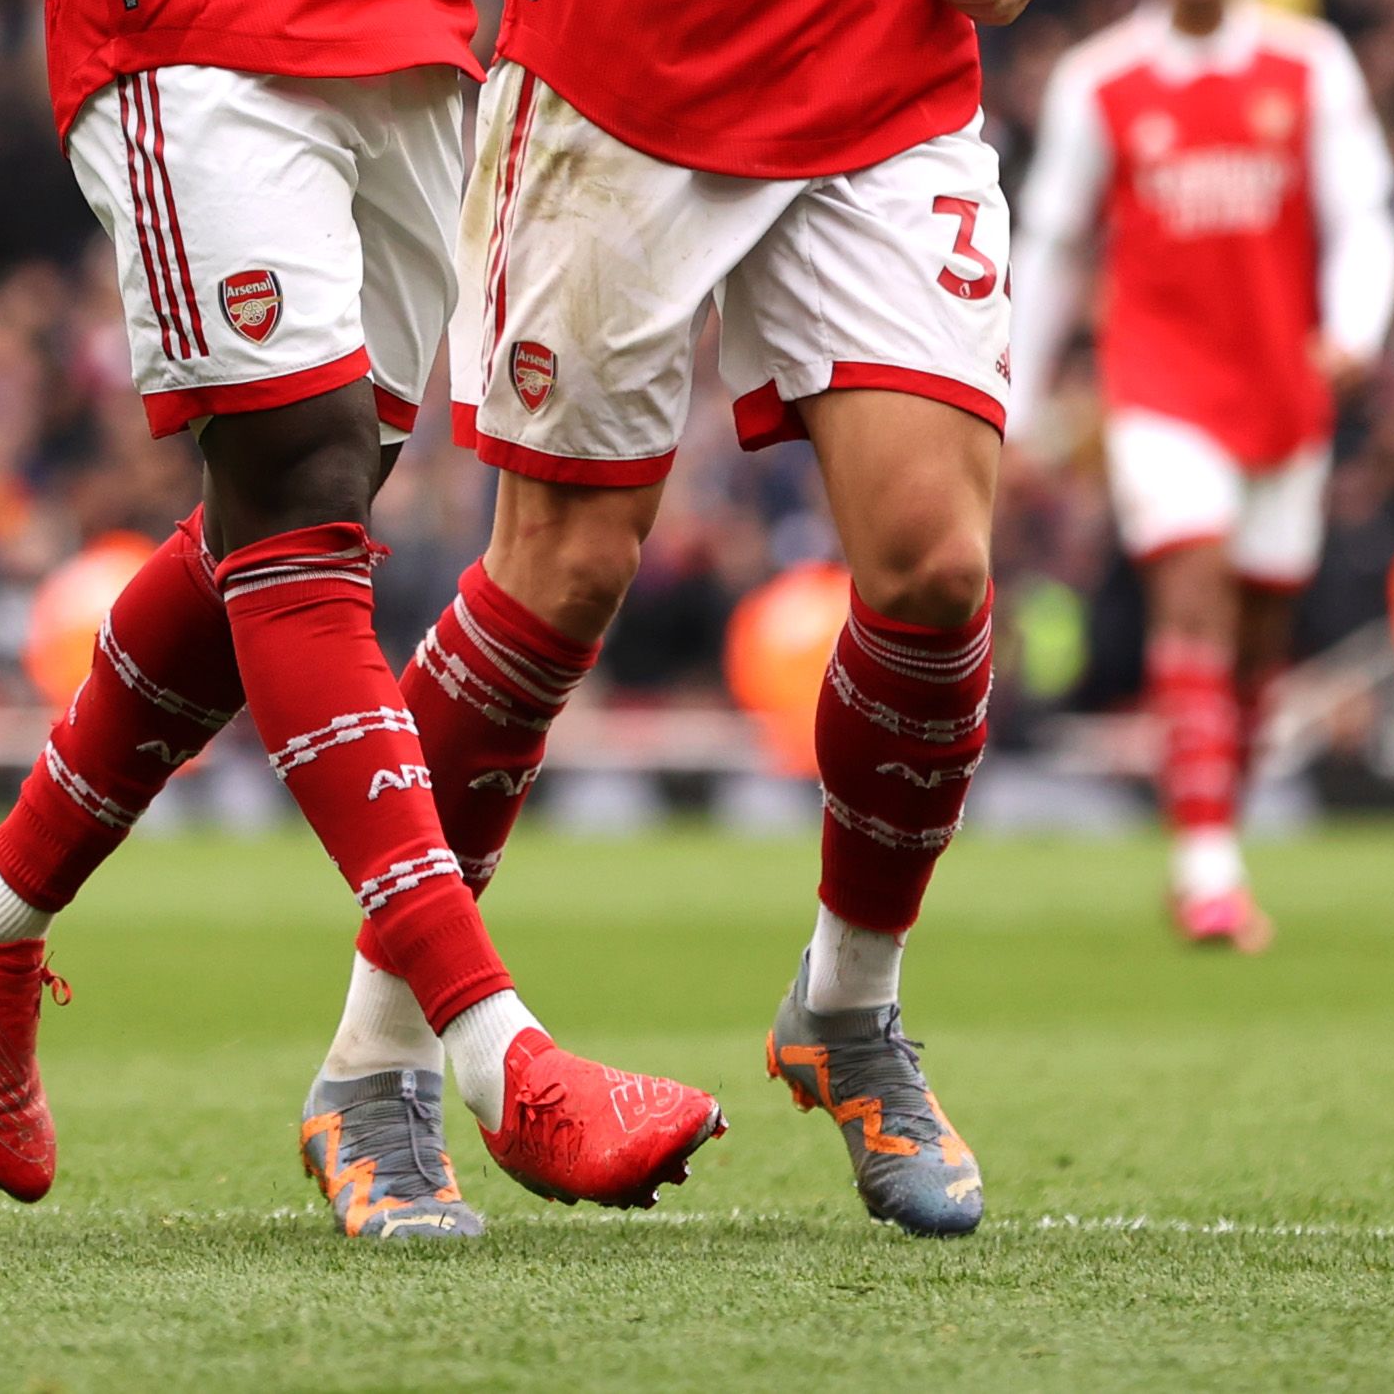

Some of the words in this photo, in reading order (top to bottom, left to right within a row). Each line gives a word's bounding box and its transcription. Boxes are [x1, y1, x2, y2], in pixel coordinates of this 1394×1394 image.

[932, 195, 1011, 300] 3
[227, 278, 272, 298] Arsenal
[135, 739, 202, 766] AF
[368, 763, 433, 801] AFC
[468, 761, 543, 797] AF
